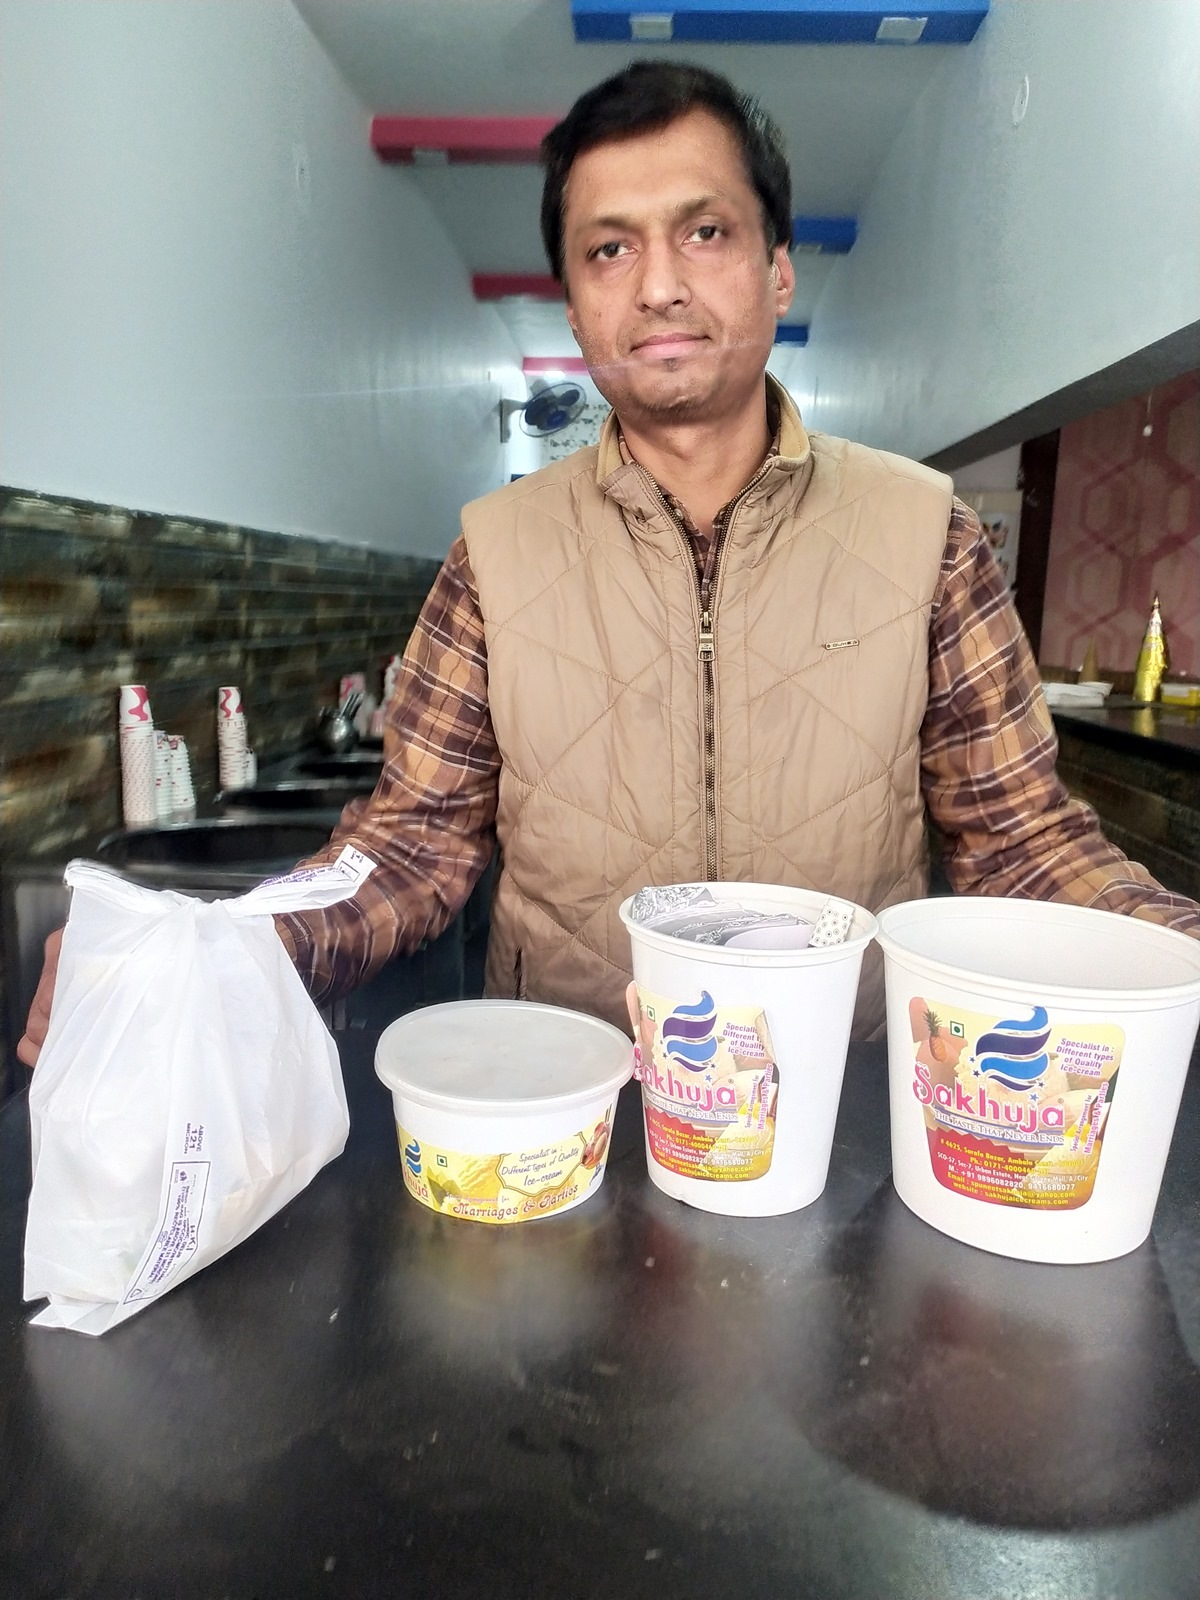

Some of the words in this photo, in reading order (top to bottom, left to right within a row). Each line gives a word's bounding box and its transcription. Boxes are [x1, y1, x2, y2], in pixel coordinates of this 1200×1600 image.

[723, 1029, 755, 1041] Different
[728, 1046, 765, 1058] Ice-cream
[740, 1041, 765, 1051] Quality
[1061, 1038, 1100, 1051] Specialist
[1056, 1046, 1092, 1058] Different
[1094, 1052, 1114, 1062] types
[1060, 1064, 1101, 1077] Ice-cream
[1075, 1058, 1102, 1069] Quality
[757, 1094, 769, 1130] Marriages
[763, 1063, 773, 1087] Parties
[912, 1062, 1065, 1132] Sakhuja
[1084, 1118, 1099, 1154] Marriages
[1096, 1082, 1109, 1108] Parties
[183, 1122, 191, 1154] MICRON
[196, 1124, 204, 1152] ABOVE
[951, 1115, 976, 1131] TASTE
[979, 1125, 1002, 1136] THAT
[1004, 1130, 1037, 1142] NEVER
[1039, 1134, 1064, 1143] ENDS
[189, 1128, 198, 1149] 121
[502, 1165, 530, 1176] Different
[532, 1161, 547, 1173] types
[558, 1147, 580, 1164] Quality
[519, 1149, 551, 1164] Specialist
[985, 1152, 1006, 1163] Bazar,
[1008, 1156, 1033, 1165] Ambala
[523, 1169, 563, 1187] Ice-cream
[452, 1202, 519, 1220] Marriages
[523, 1200, 537, 1213] &
[539, 1184, 579, 1209] Parties
